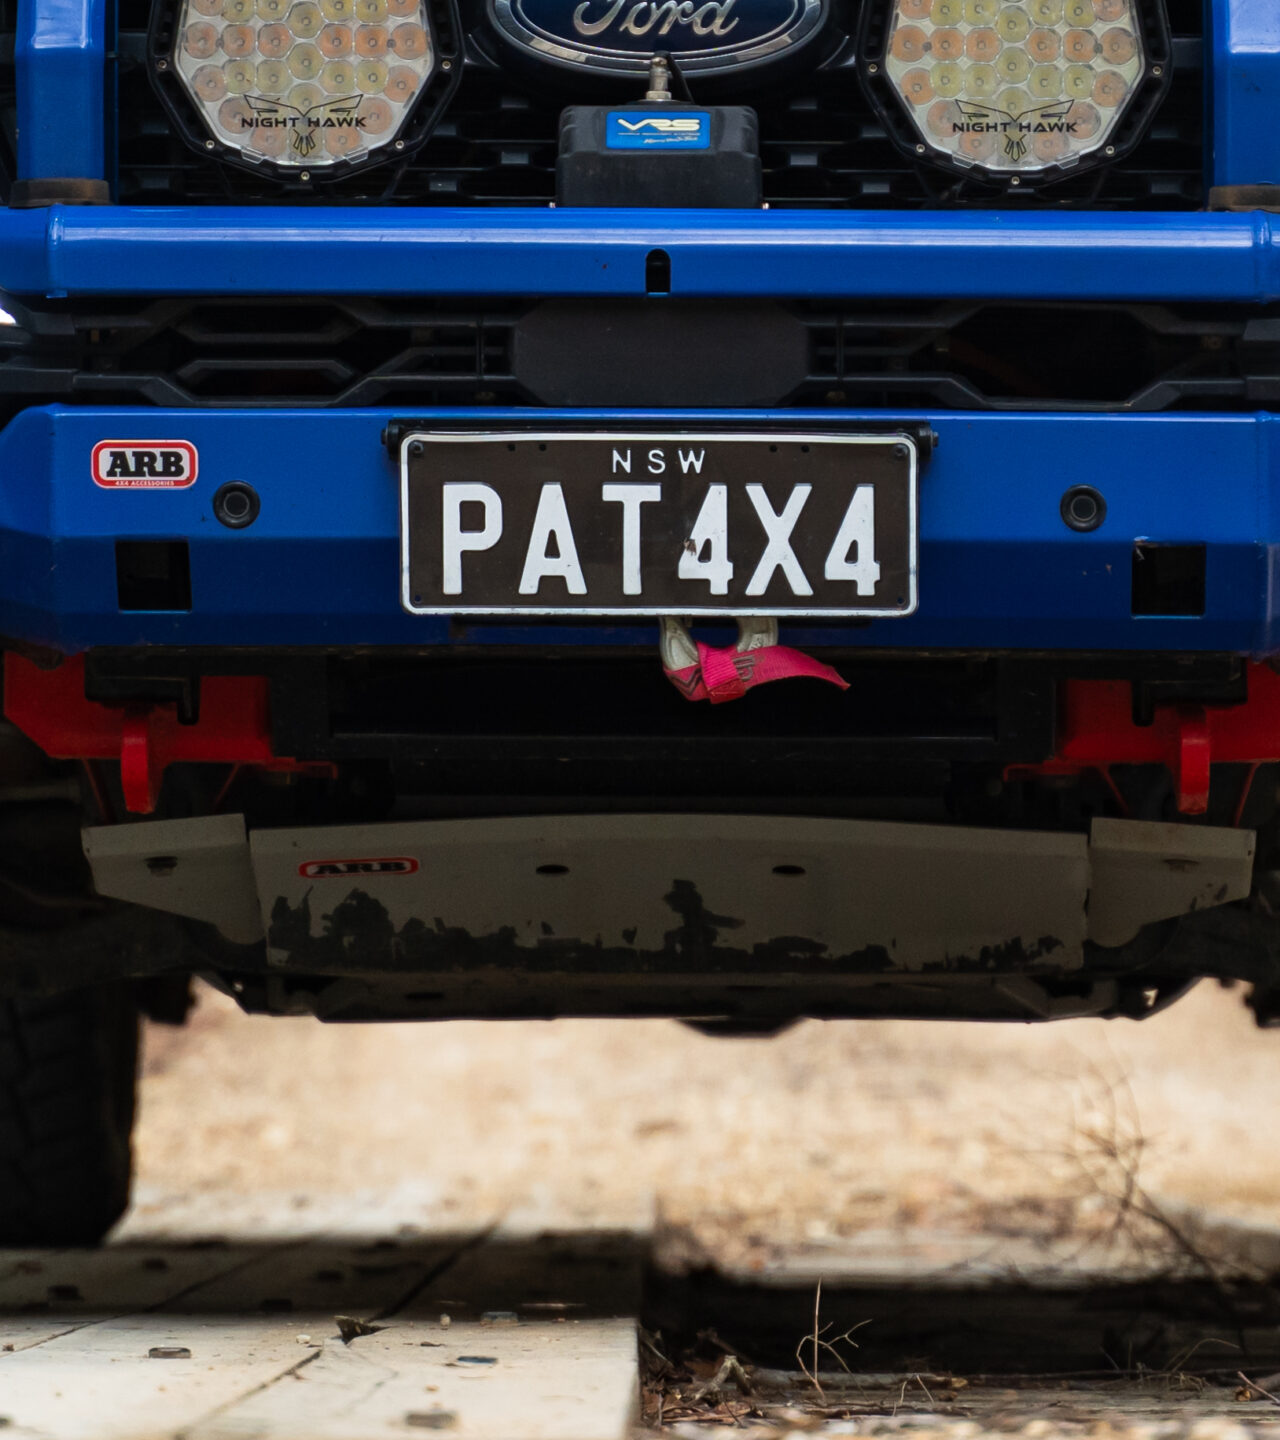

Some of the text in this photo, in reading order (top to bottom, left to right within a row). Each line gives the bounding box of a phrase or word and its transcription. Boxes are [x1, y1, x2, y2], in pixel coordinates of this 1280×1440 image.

[241, 117, 367, 127] NIGHT HAWK
[618, 119, 700, 131] VRS
[952, 122, 1077, 132] NIGHT HAWK
[106, 451, 185, 477] ARB
[442, 482, 881, 596] PAT4X4
[312, 862, 407, 875] ARB
